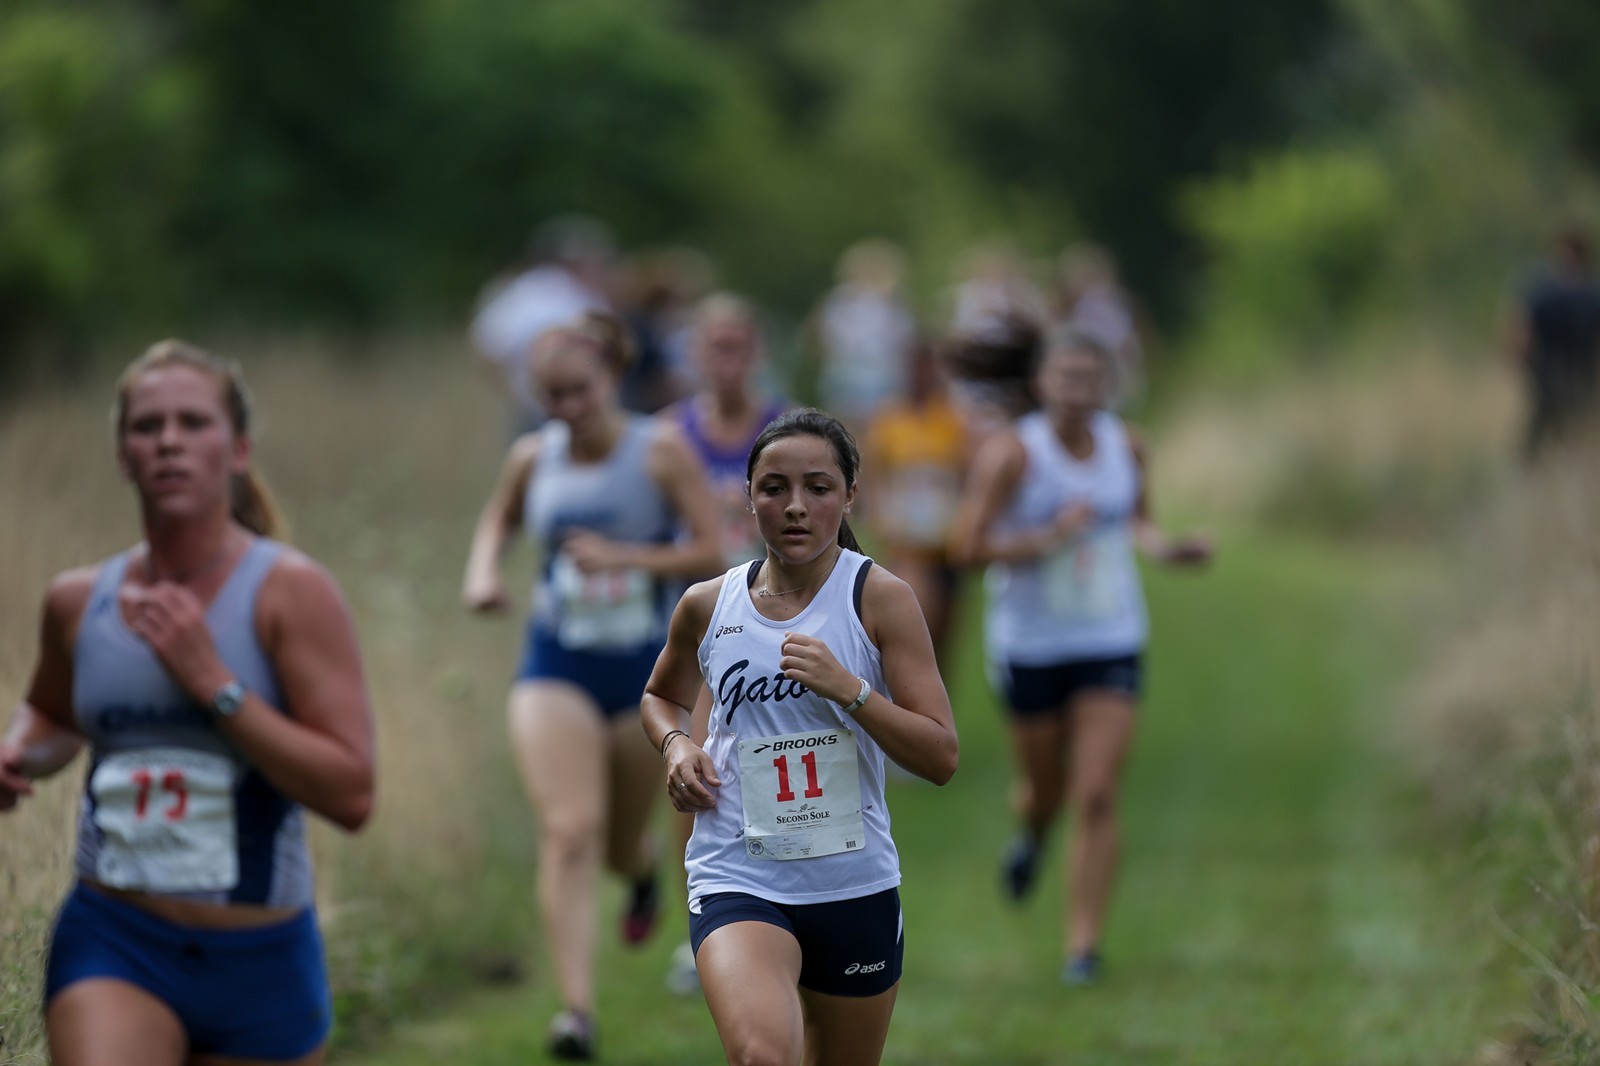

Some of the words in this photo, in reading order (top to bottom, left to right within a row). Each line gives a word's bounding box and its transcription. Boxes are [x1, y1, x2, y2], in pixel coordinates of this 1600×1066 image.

[722, 625, 744, 635] asics
[718, 659, 812, 726] Gato
[772, 734, 838, 752] BROOKS
[773, 751, 823, 802] 11
[776, 814, 809, 825] SECOND
[810, 810, 831, 820] SOLE
[860, 960, 886, 974] asics
